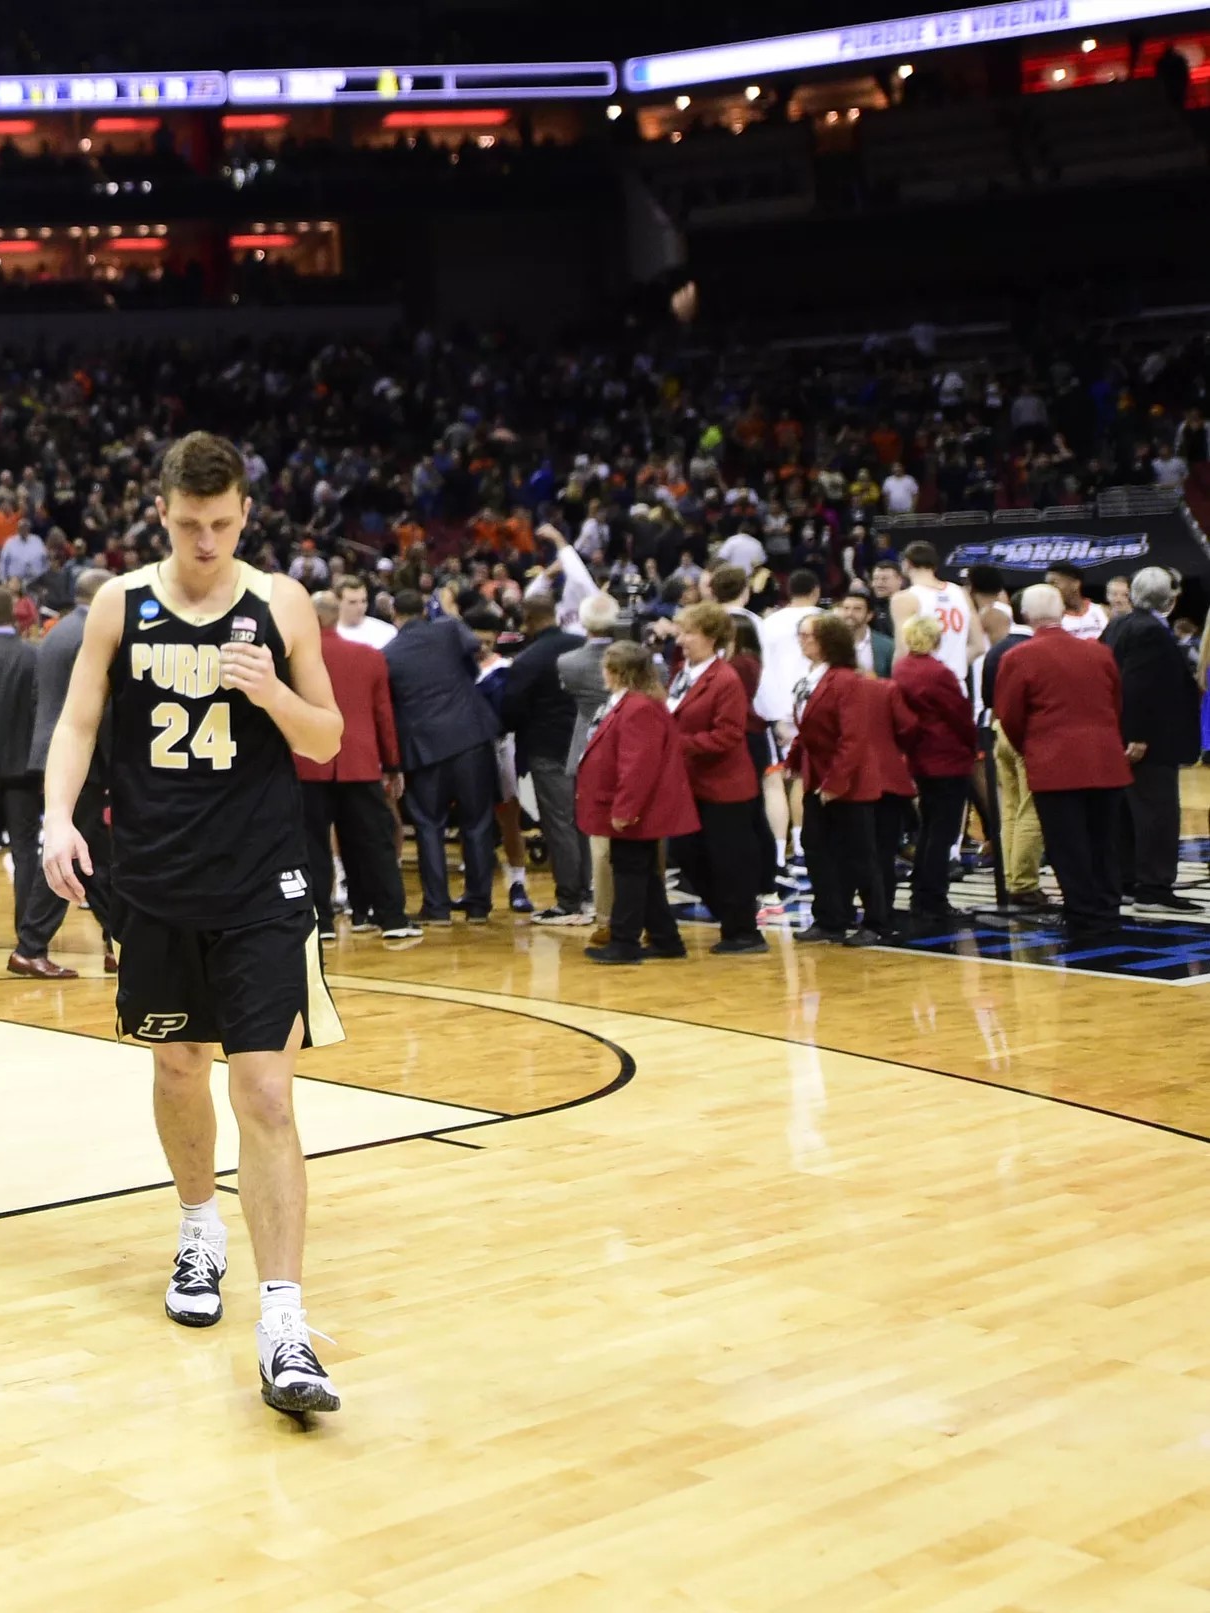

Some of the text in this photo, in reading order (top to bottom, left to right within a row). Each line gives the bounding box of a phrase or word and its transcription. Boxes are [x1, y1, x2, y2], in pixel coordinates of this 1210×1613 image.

[934, 607, 964, 633] 30
[150, 702, 237, 770] 24
[136, 1013, 189, 1039] P
